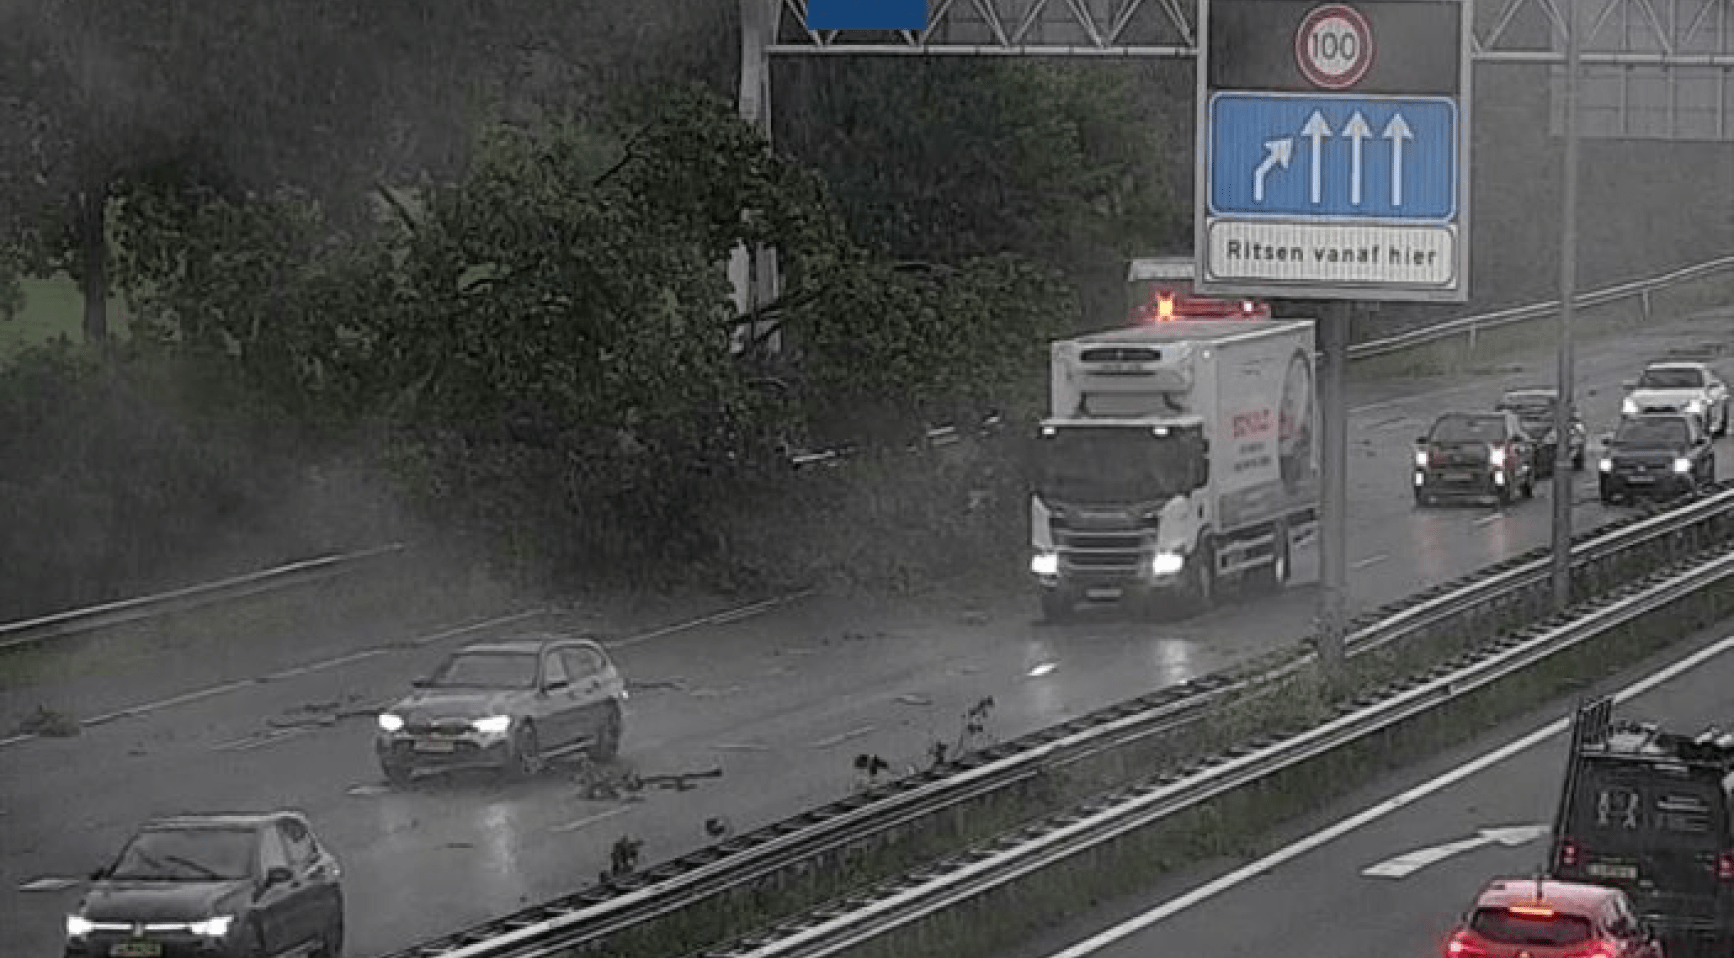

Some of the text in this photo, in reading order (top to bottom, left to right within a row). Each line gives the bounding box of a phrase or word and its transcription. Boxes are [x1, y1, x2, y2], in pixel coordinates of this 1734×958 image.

[1312, 32, 1356, 61] 100
[1226, 240, 1437, 265] Ritsen vanaf hier
